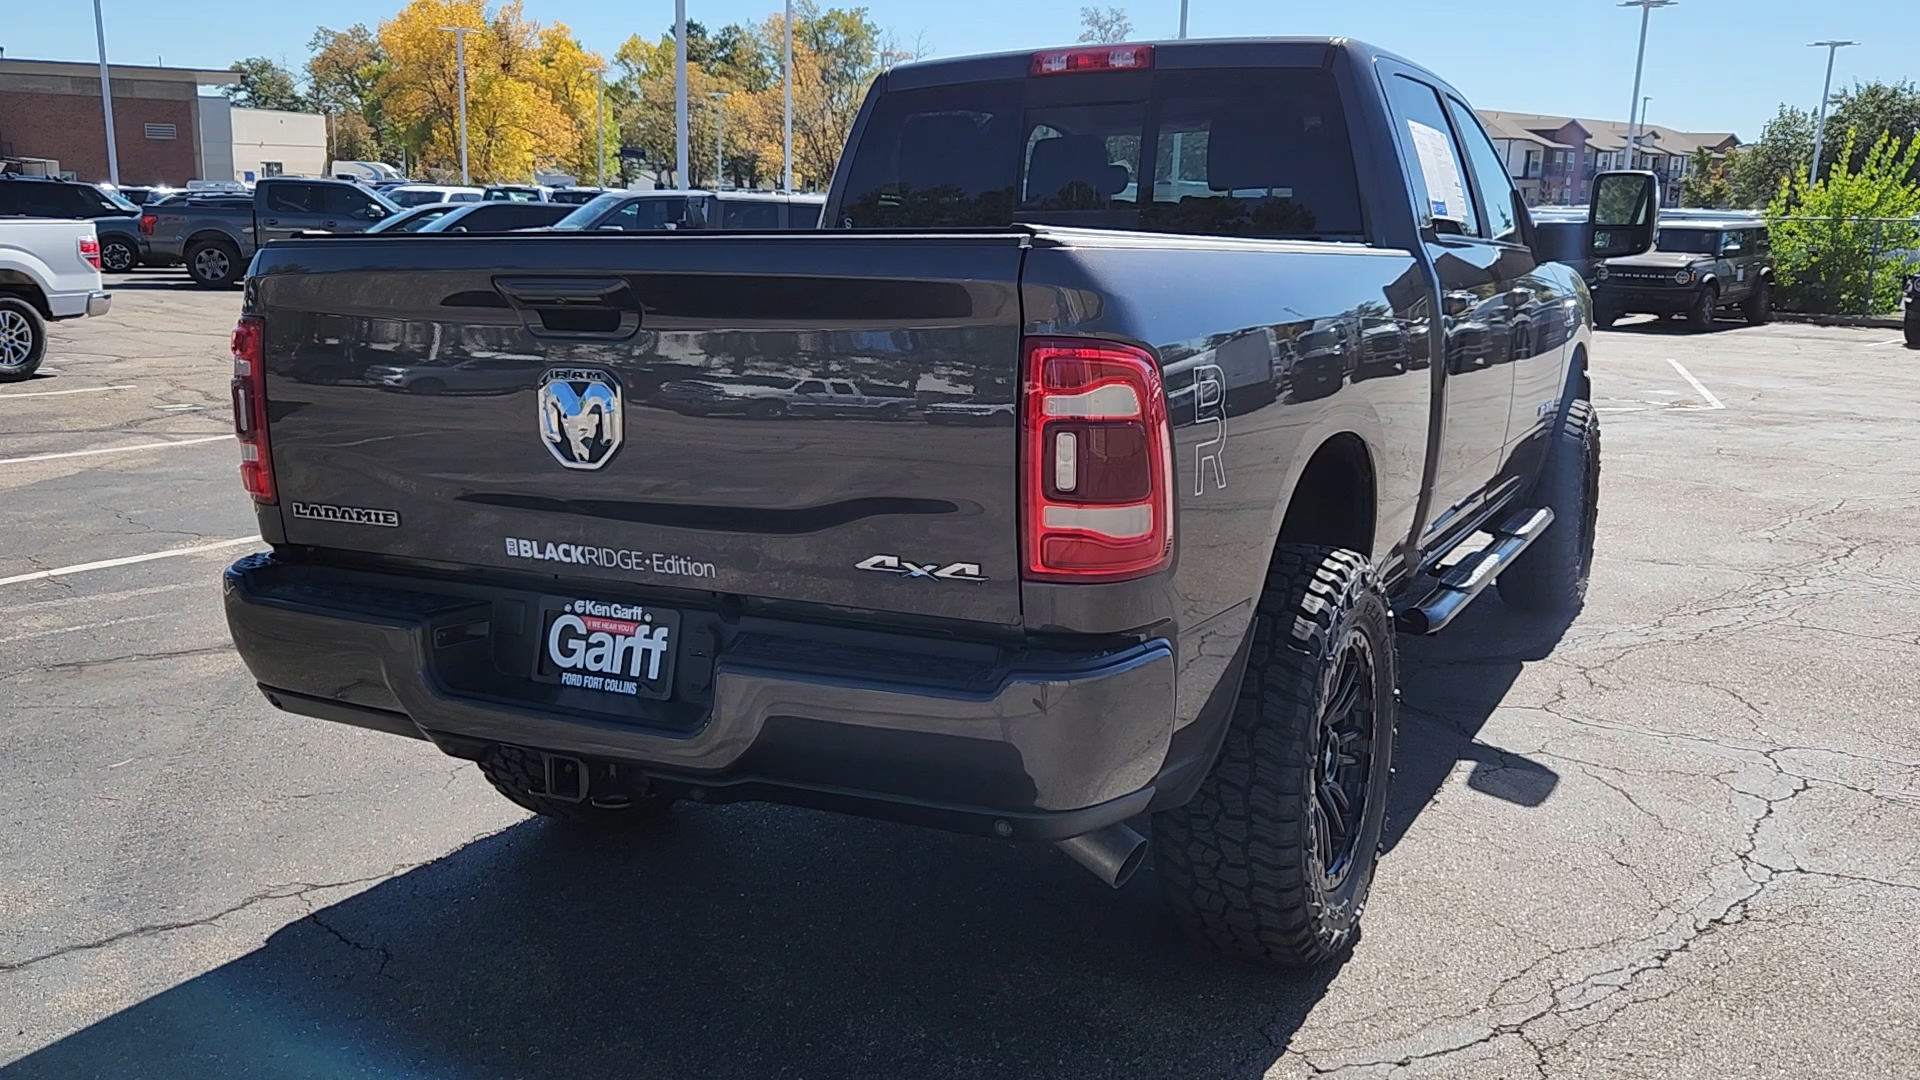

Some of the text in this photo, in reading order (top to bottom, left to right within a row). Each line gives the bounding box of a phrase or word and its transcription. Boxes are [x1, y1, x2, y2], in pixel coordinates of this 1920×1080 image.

[553, 370, 602, 380] RAM
[292, 502, 399, 527] LARAMIE
[591, 620, 630, 632] WE HEAR YOU
[549, 614, 668, 680] Garff
[561, 672, 637, 695] FORD FORT COLLINS
